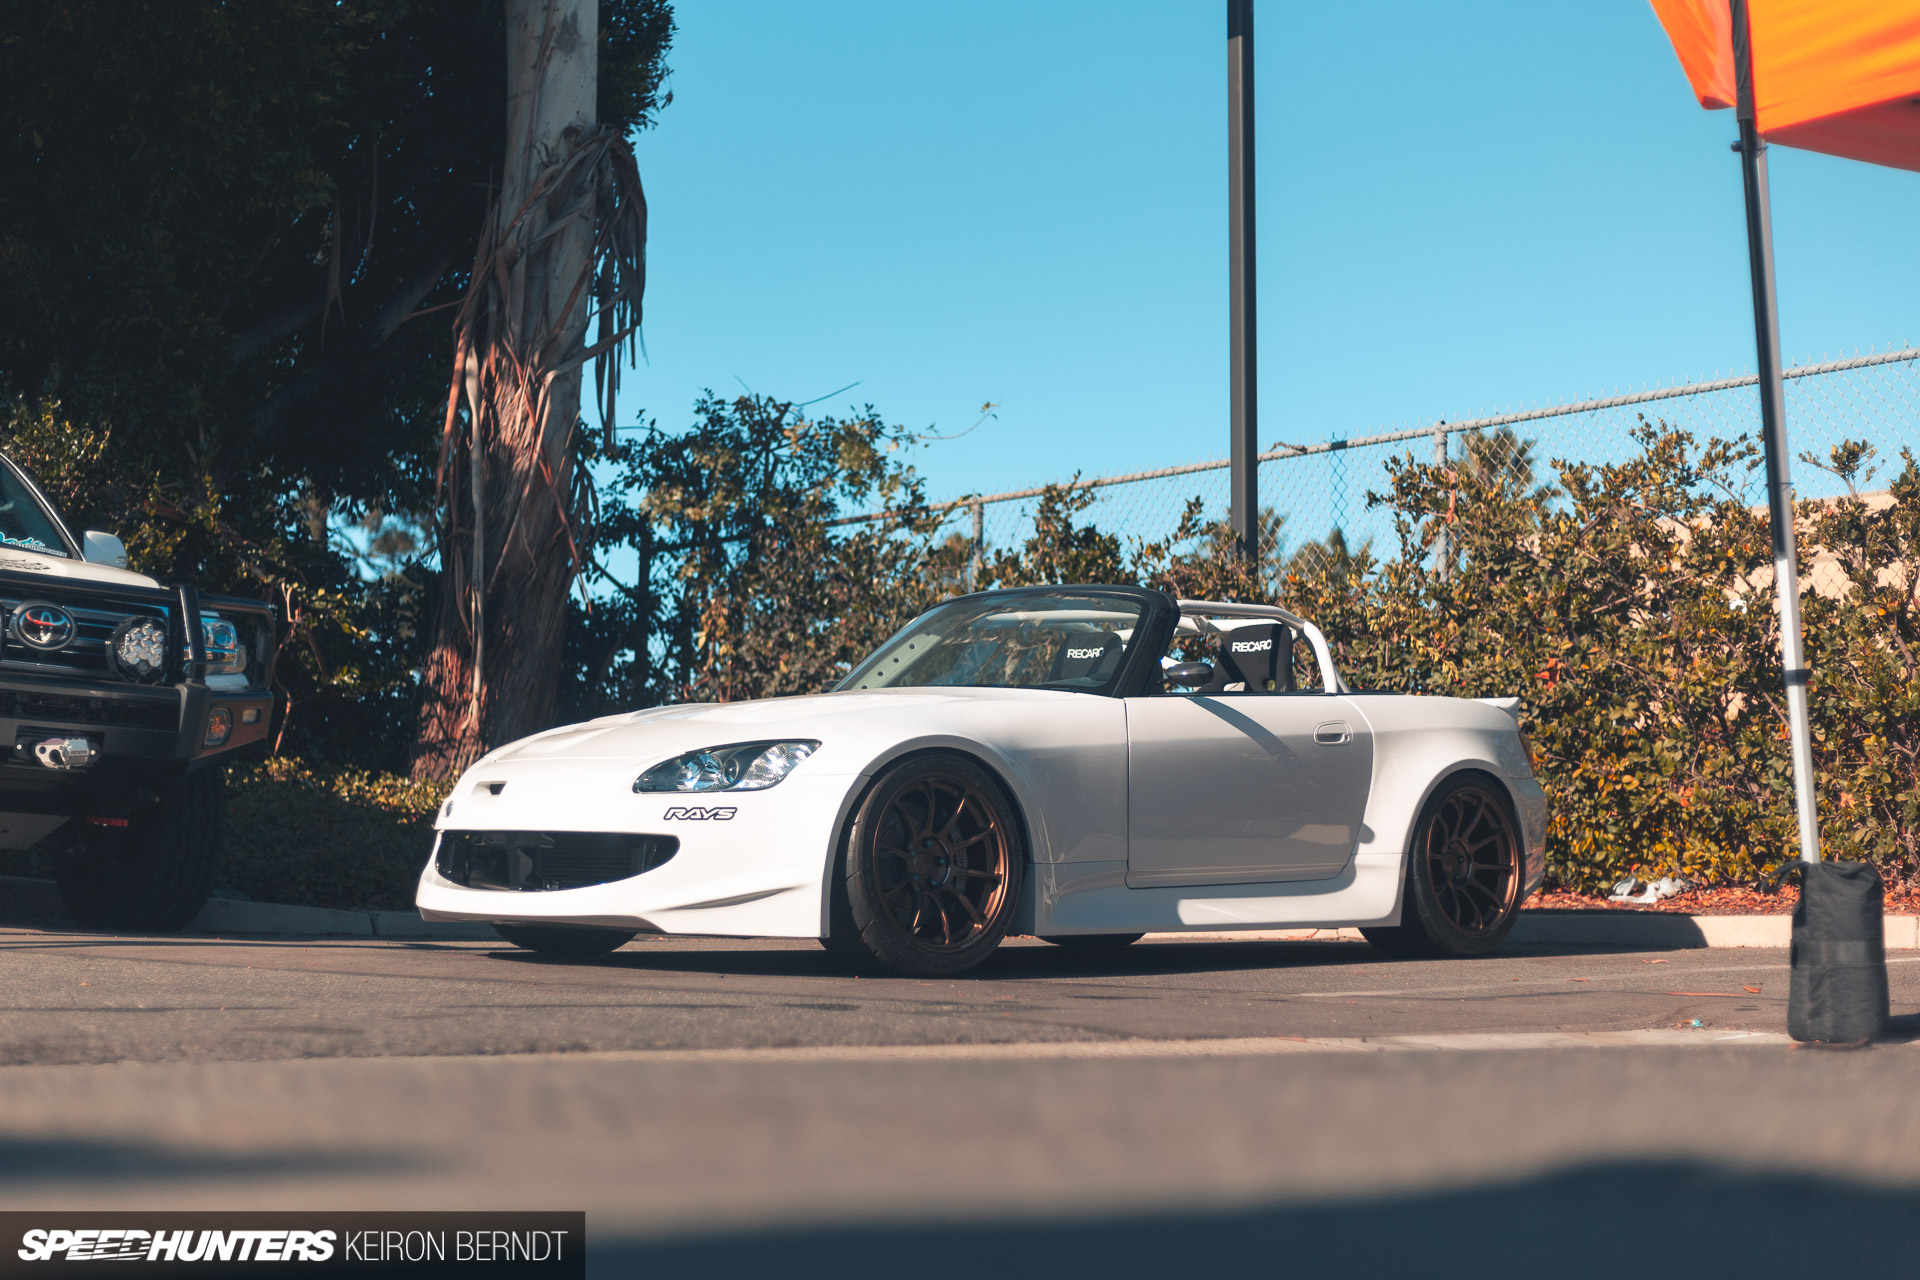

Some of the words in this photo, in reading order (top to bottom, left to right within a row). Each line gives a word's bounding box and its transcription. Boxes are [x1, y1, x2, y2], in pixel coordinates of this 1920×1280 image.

[1232, 639, 1272, 652] RECARO
[1066, 647, 1104, 659] RECARO
[663, 806, 738, 821] RAYS
